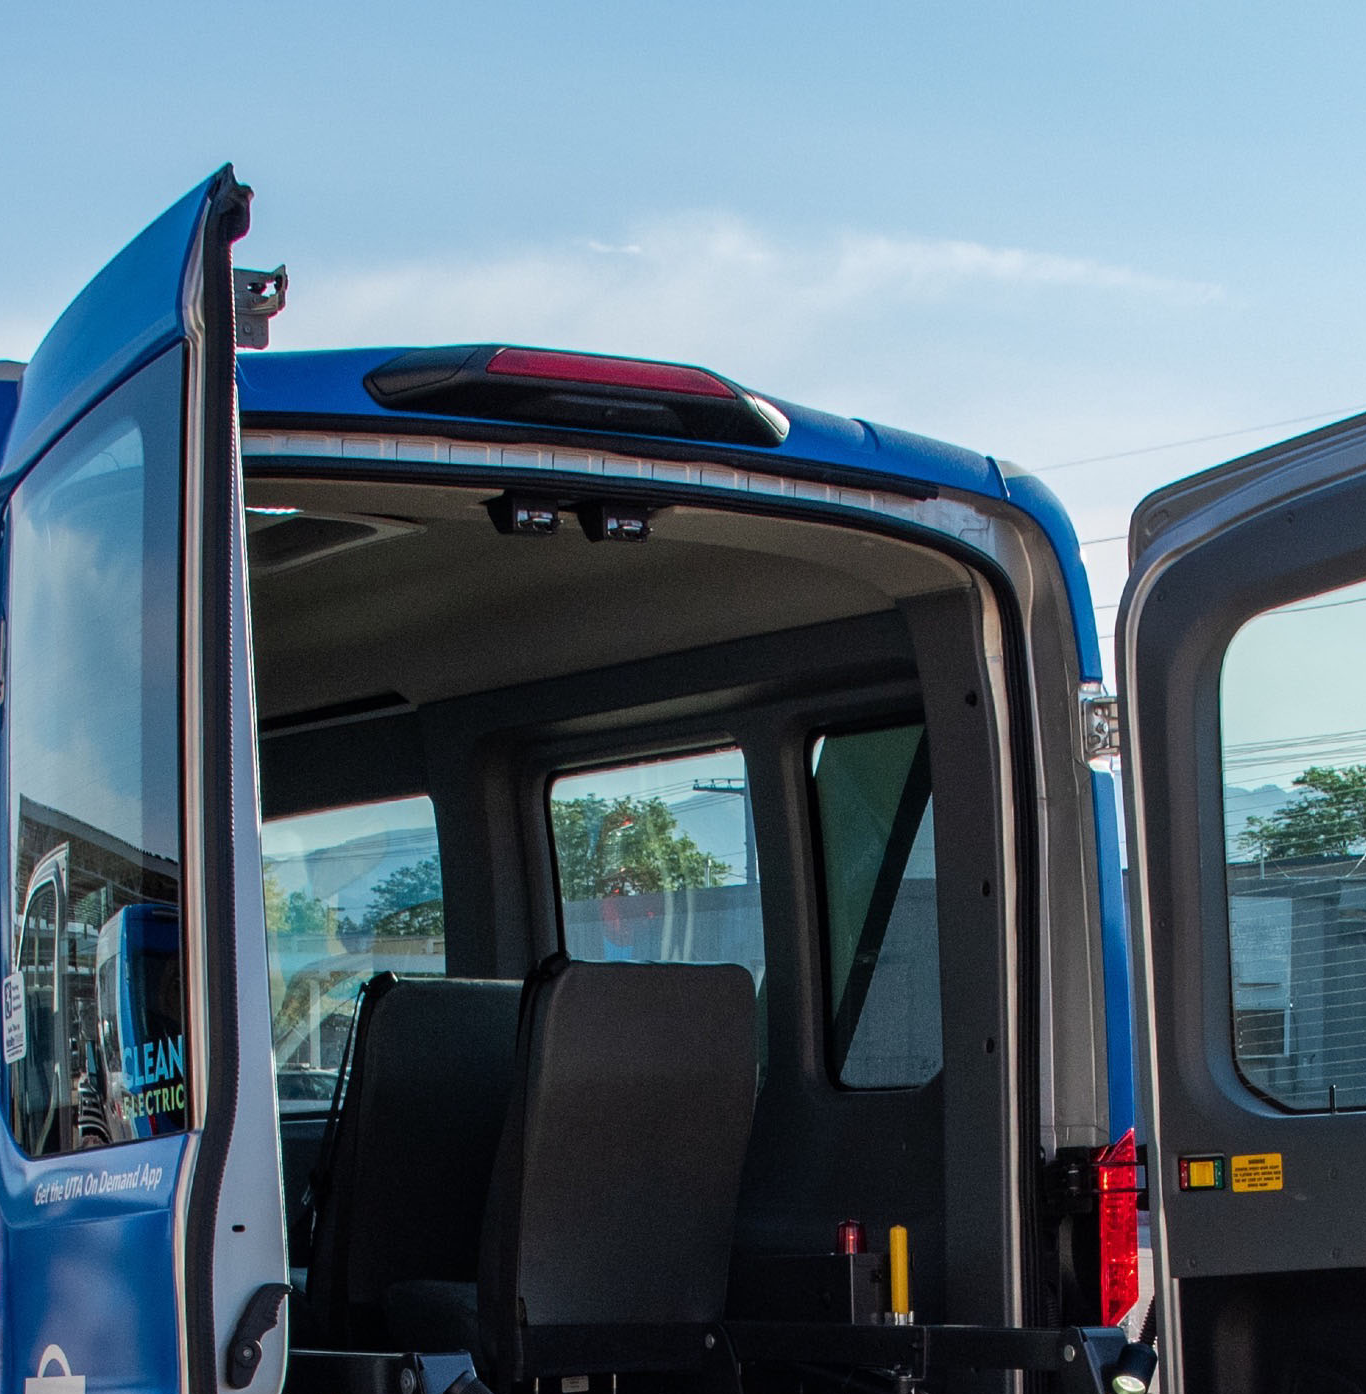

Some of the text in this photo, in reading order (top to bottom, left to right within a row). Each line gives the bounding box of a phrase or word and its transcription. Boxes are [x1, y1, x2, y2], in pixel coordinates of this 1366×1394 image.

[122, 1034, 184, 1091] CLEAN
[123, 1083, 185, 1120] ELECTRIC
[35, 1162, 163, 1206] Get the UTA On Demand App
